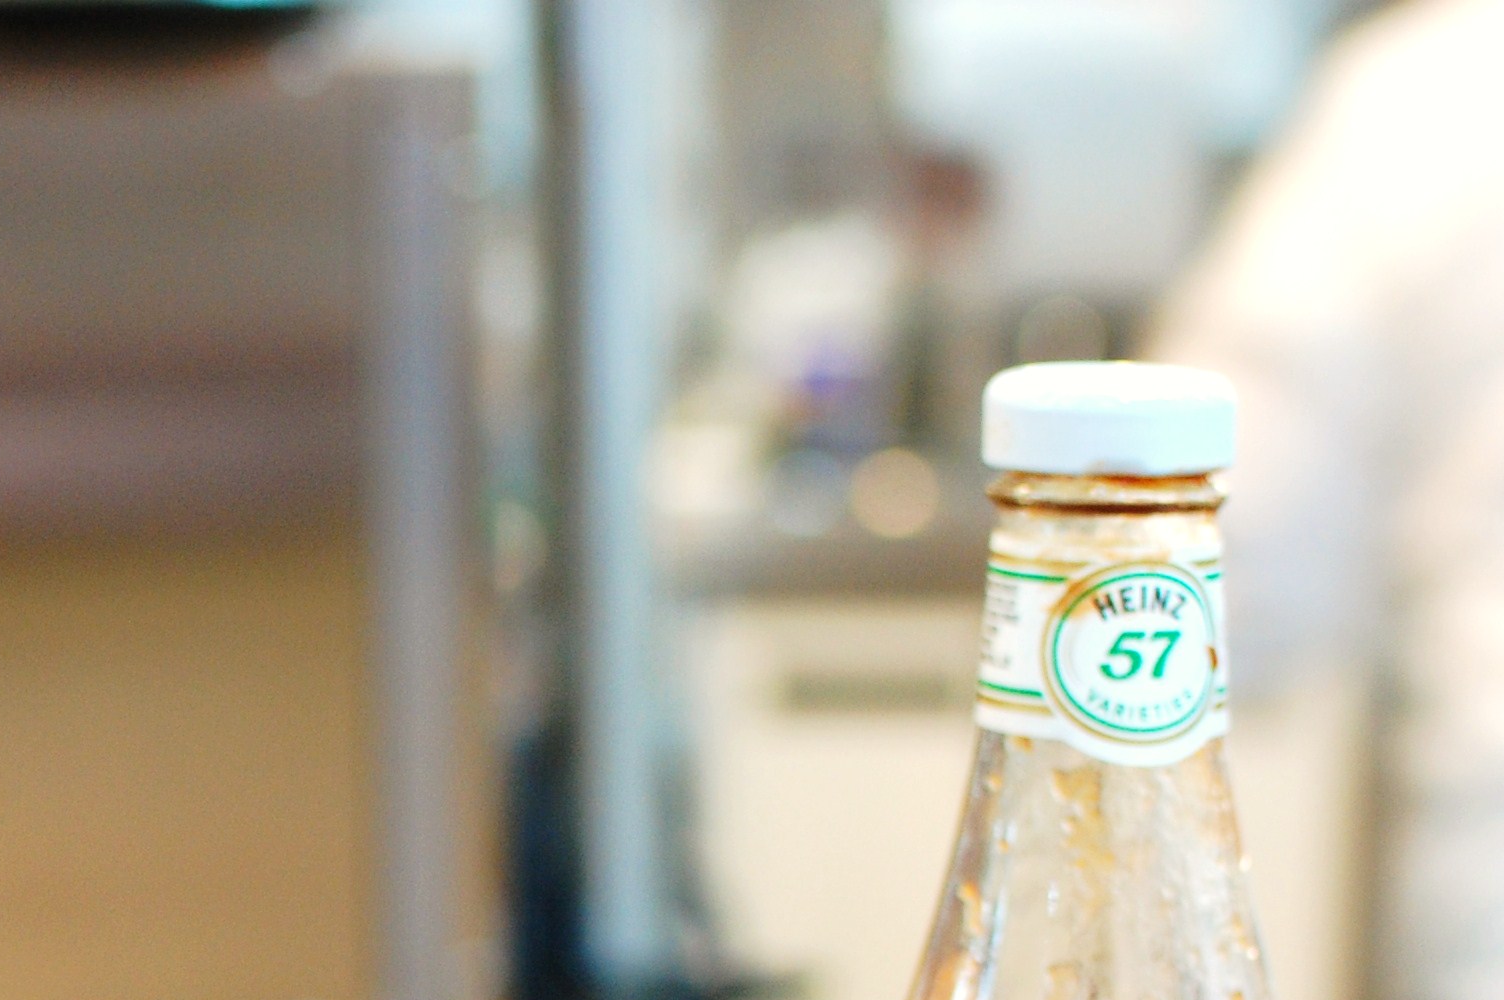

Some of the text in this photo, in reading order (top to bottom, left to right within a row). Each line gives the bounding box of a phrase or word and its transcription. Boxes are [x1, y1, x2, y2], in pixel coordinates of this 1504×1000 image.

[1091, 585, 1188, 622] HEINZ
[1099, 630, 1182, 680] 57
[1087, 687, 1193, 719] VARIETIES
